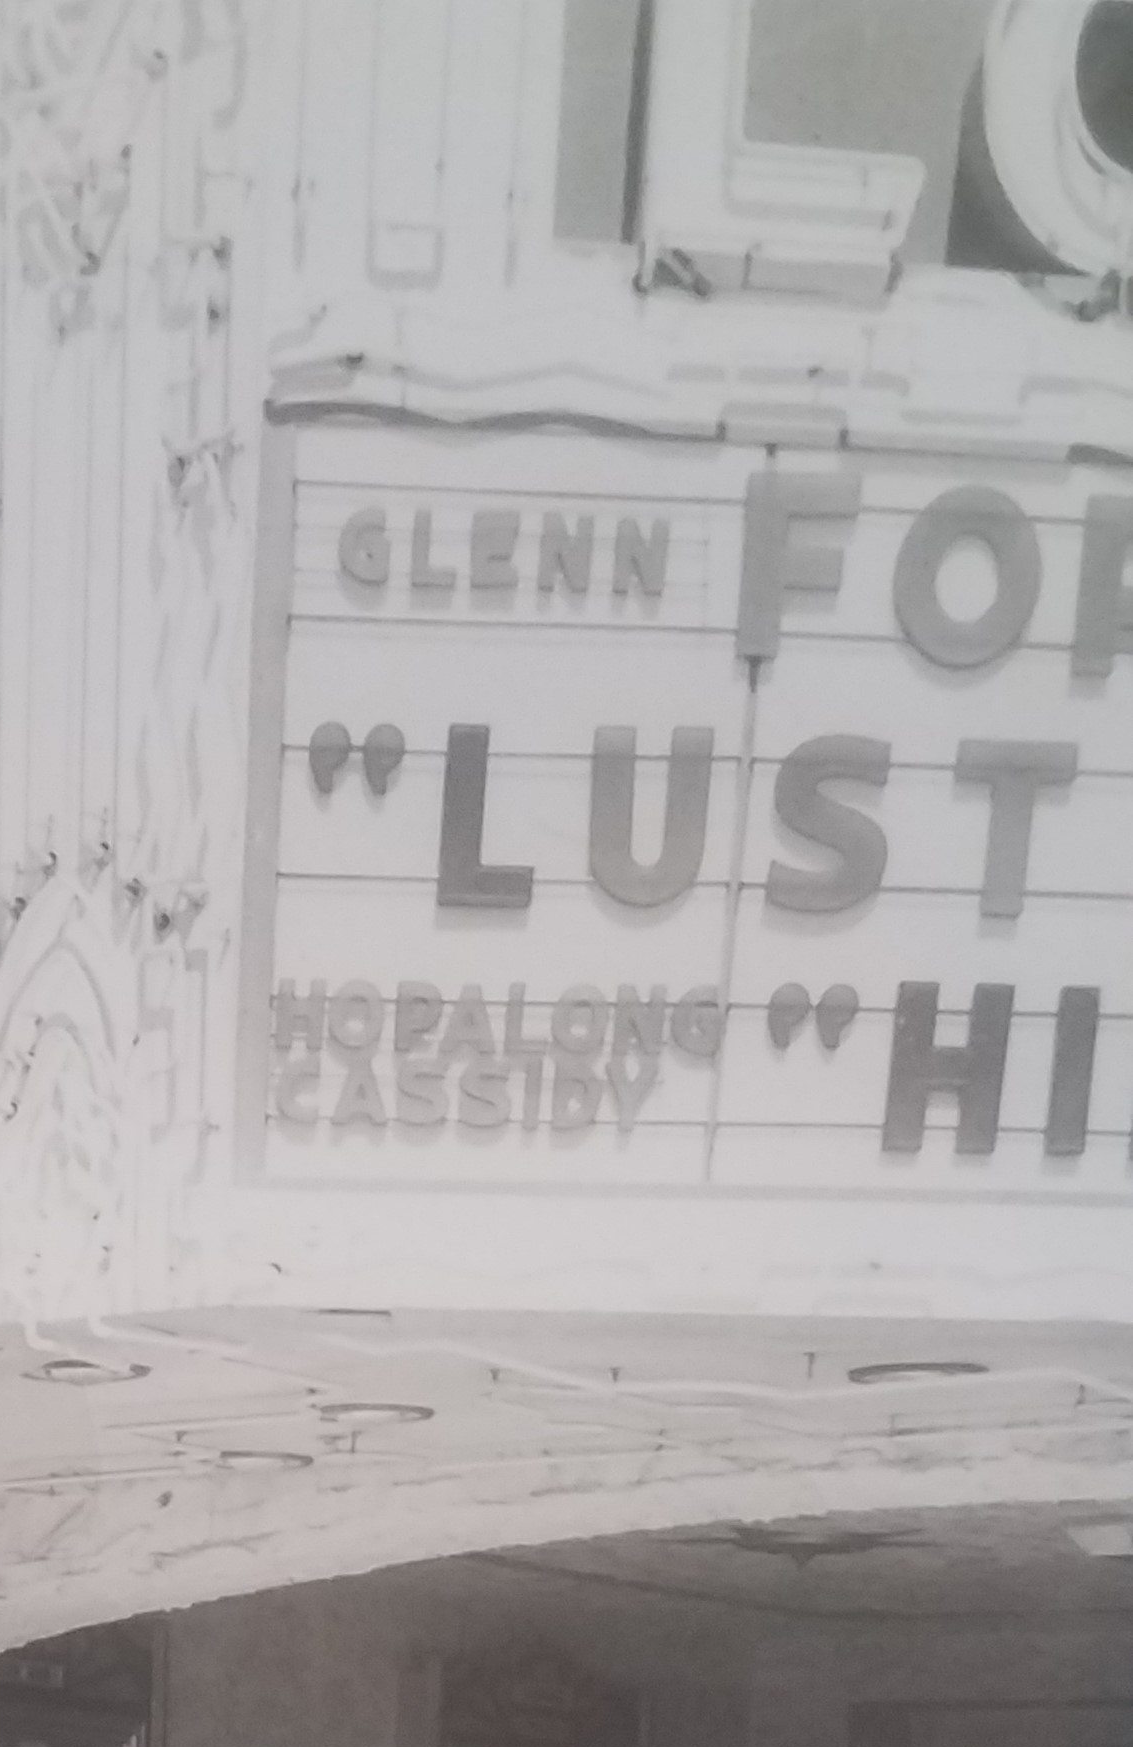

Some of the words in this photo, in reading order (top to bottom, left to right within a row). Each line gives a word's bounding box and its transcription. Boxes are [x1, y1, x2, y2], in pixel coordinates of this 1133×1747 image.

[337, 506, 672, 597] GLENN
[272, 977, 728, 1059] HOPALONG
[272, 1056, 663, 1132] CASSIDY
